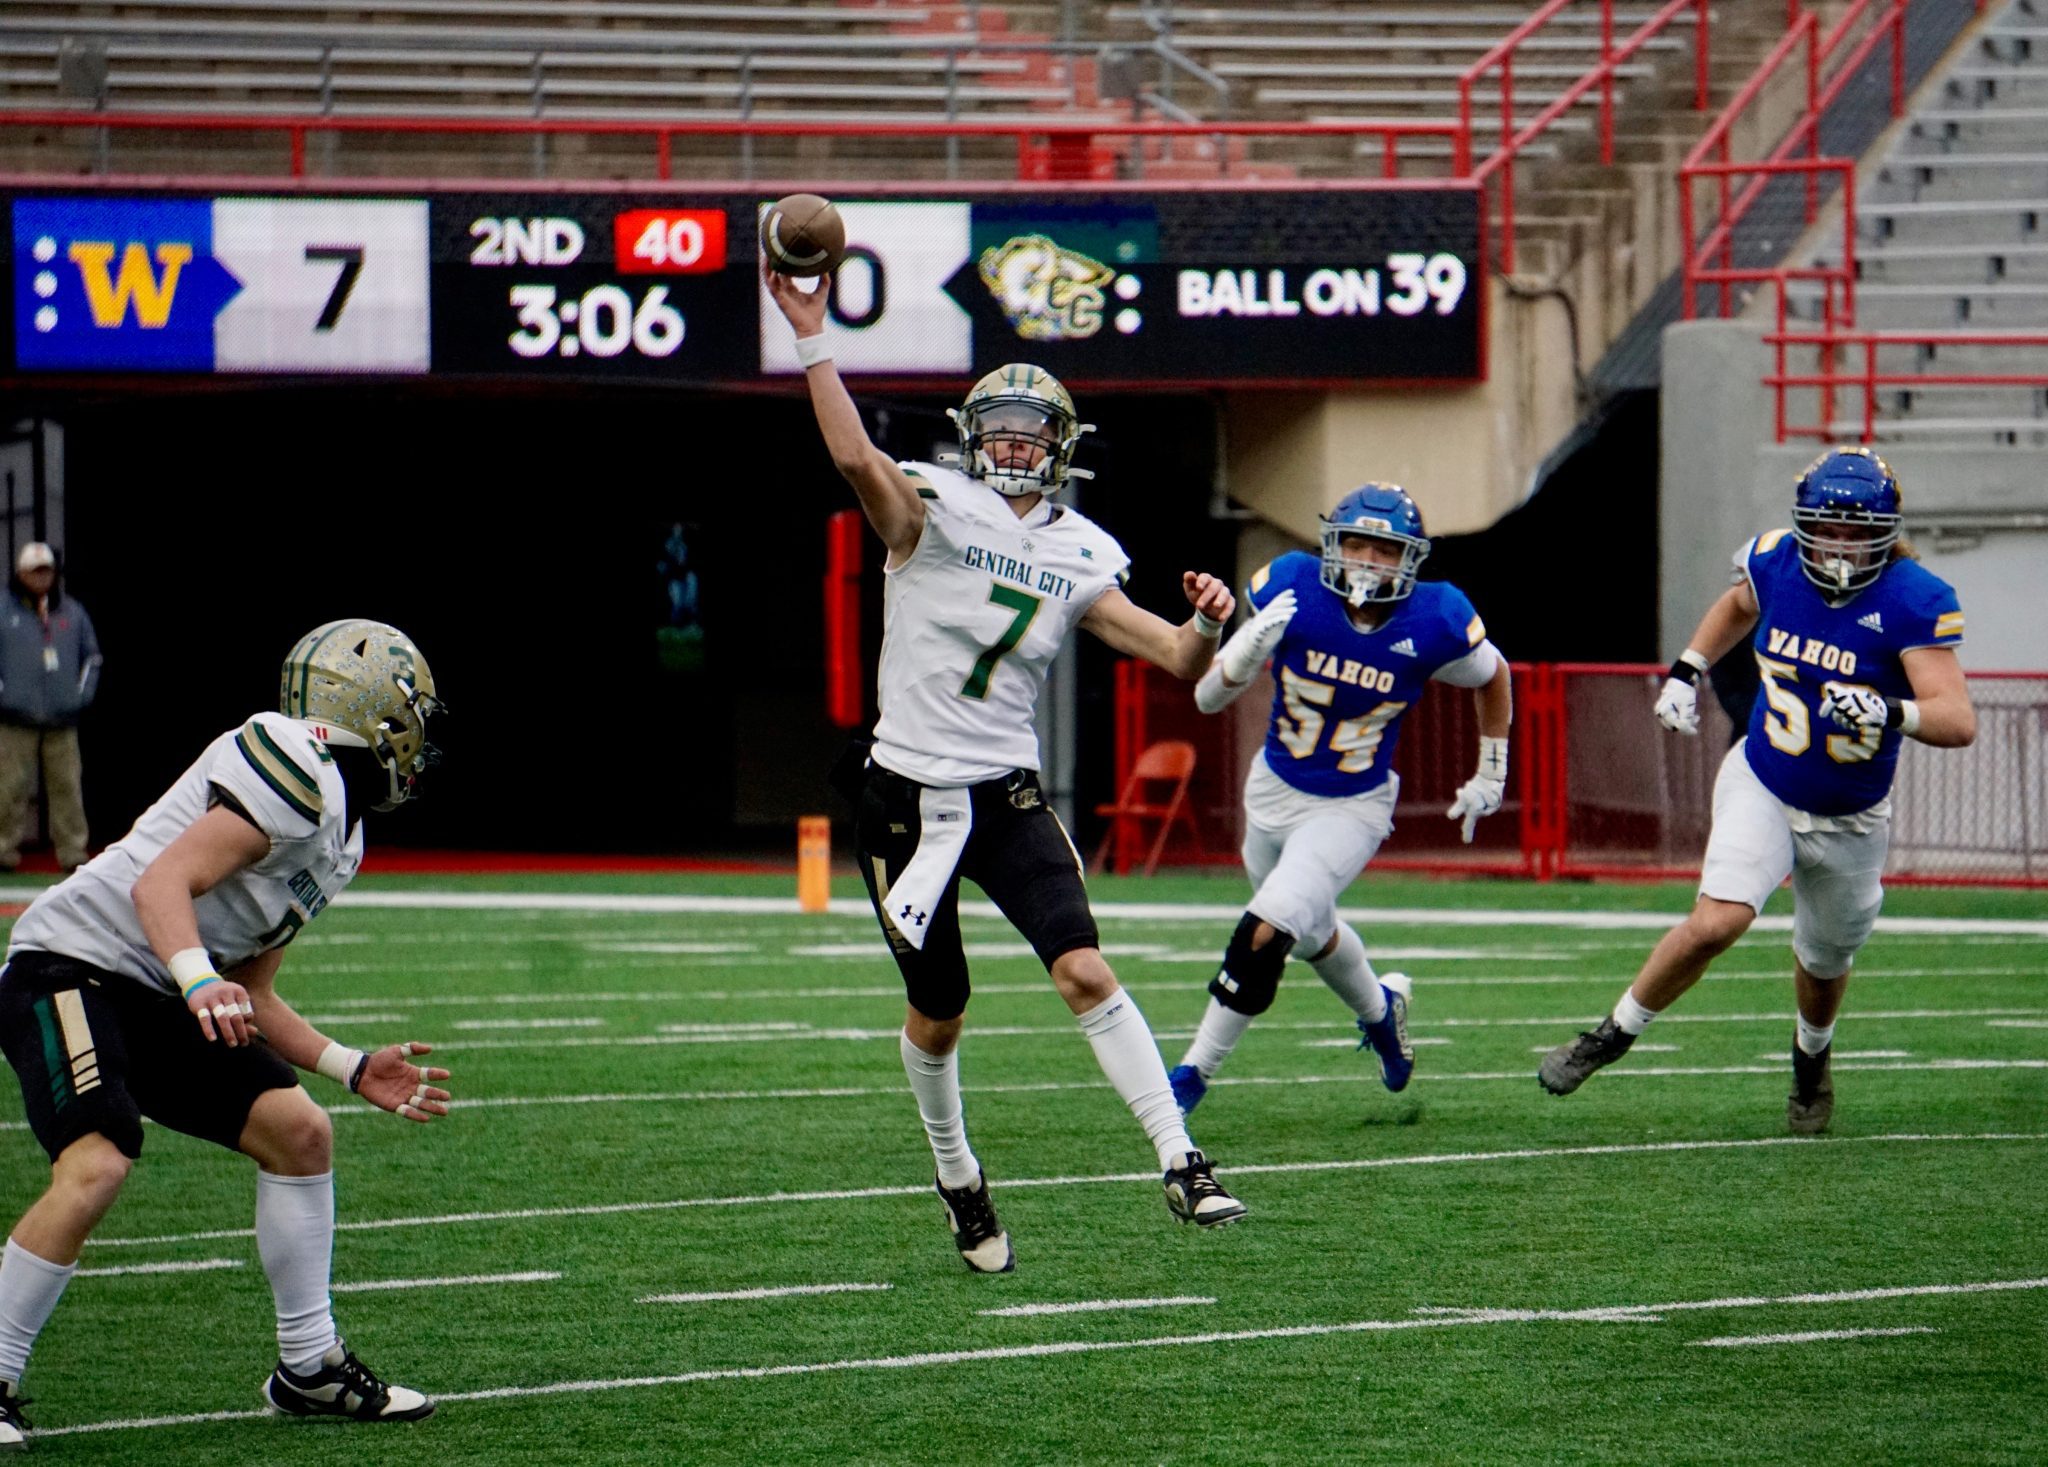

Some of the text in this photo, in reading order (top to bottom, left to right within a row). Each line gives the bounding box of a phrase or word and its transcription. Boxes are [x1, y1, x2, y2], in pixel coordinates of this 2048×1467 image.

[469, 218, 585, 265] 2ND
[632, 219, 706, 265] 40
[69, 242, 193, 328] W
[305, 245, 365, 332] 7
[827, 244, 886, 329] 0
[1178, 253, 1467, 316] BALL ON 39
[510, 284, 686, 357] 3:06
[964, 545, 1032, 587] CENTRAL
[1038, 571, 1077, 601] CITY
[959, 581, 1043, 701] 7
[1306, 649, 1395, 694] WAHOO
[1768, 628, 1857, 676] WAHOO
[1278, 666, 1408, 773] 54
